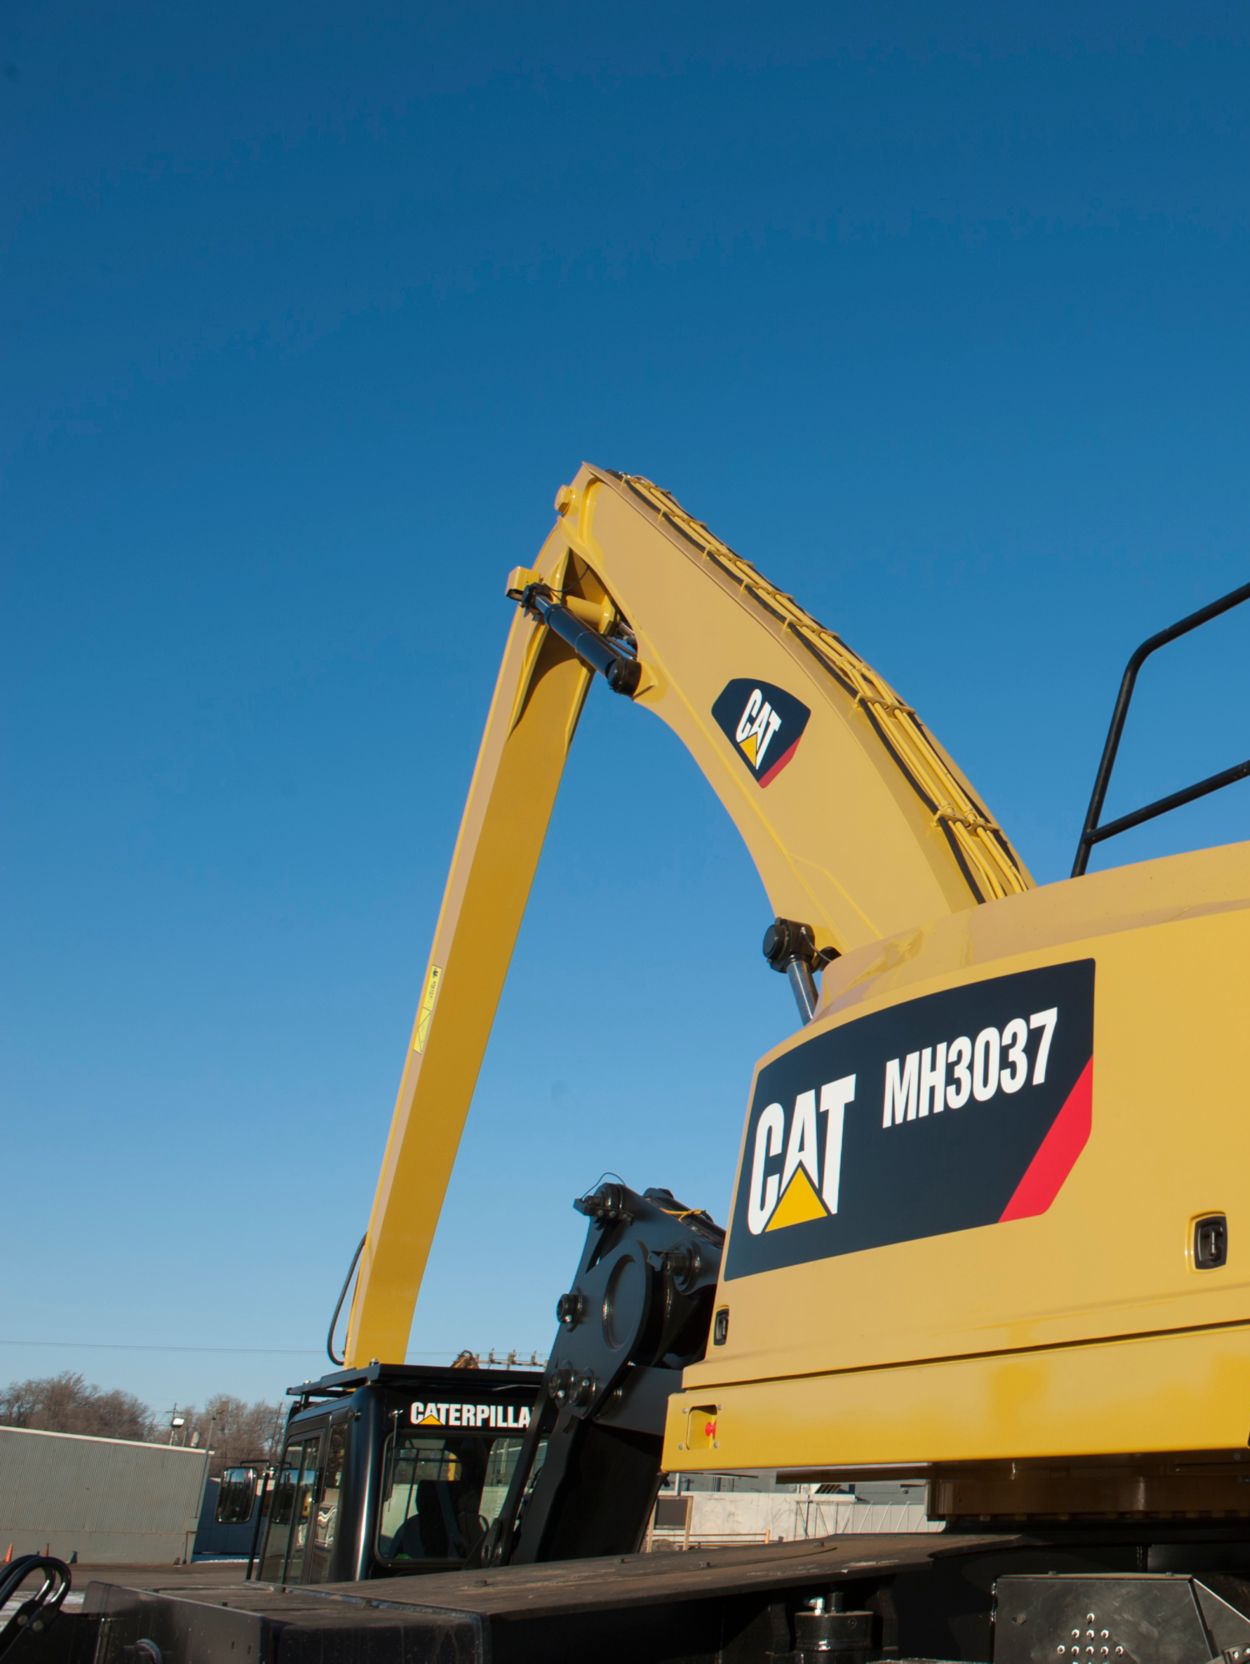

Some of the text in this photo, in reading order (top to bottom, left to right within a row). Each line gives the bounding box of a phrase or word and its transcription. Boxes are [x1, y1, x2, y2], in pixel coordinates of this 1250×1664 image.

[735, 688, 782, 771] CAT
[747, 1006, 1058, 1236] CAT MH3037
[410, 1401, 534, 1428] CATERPILLA
